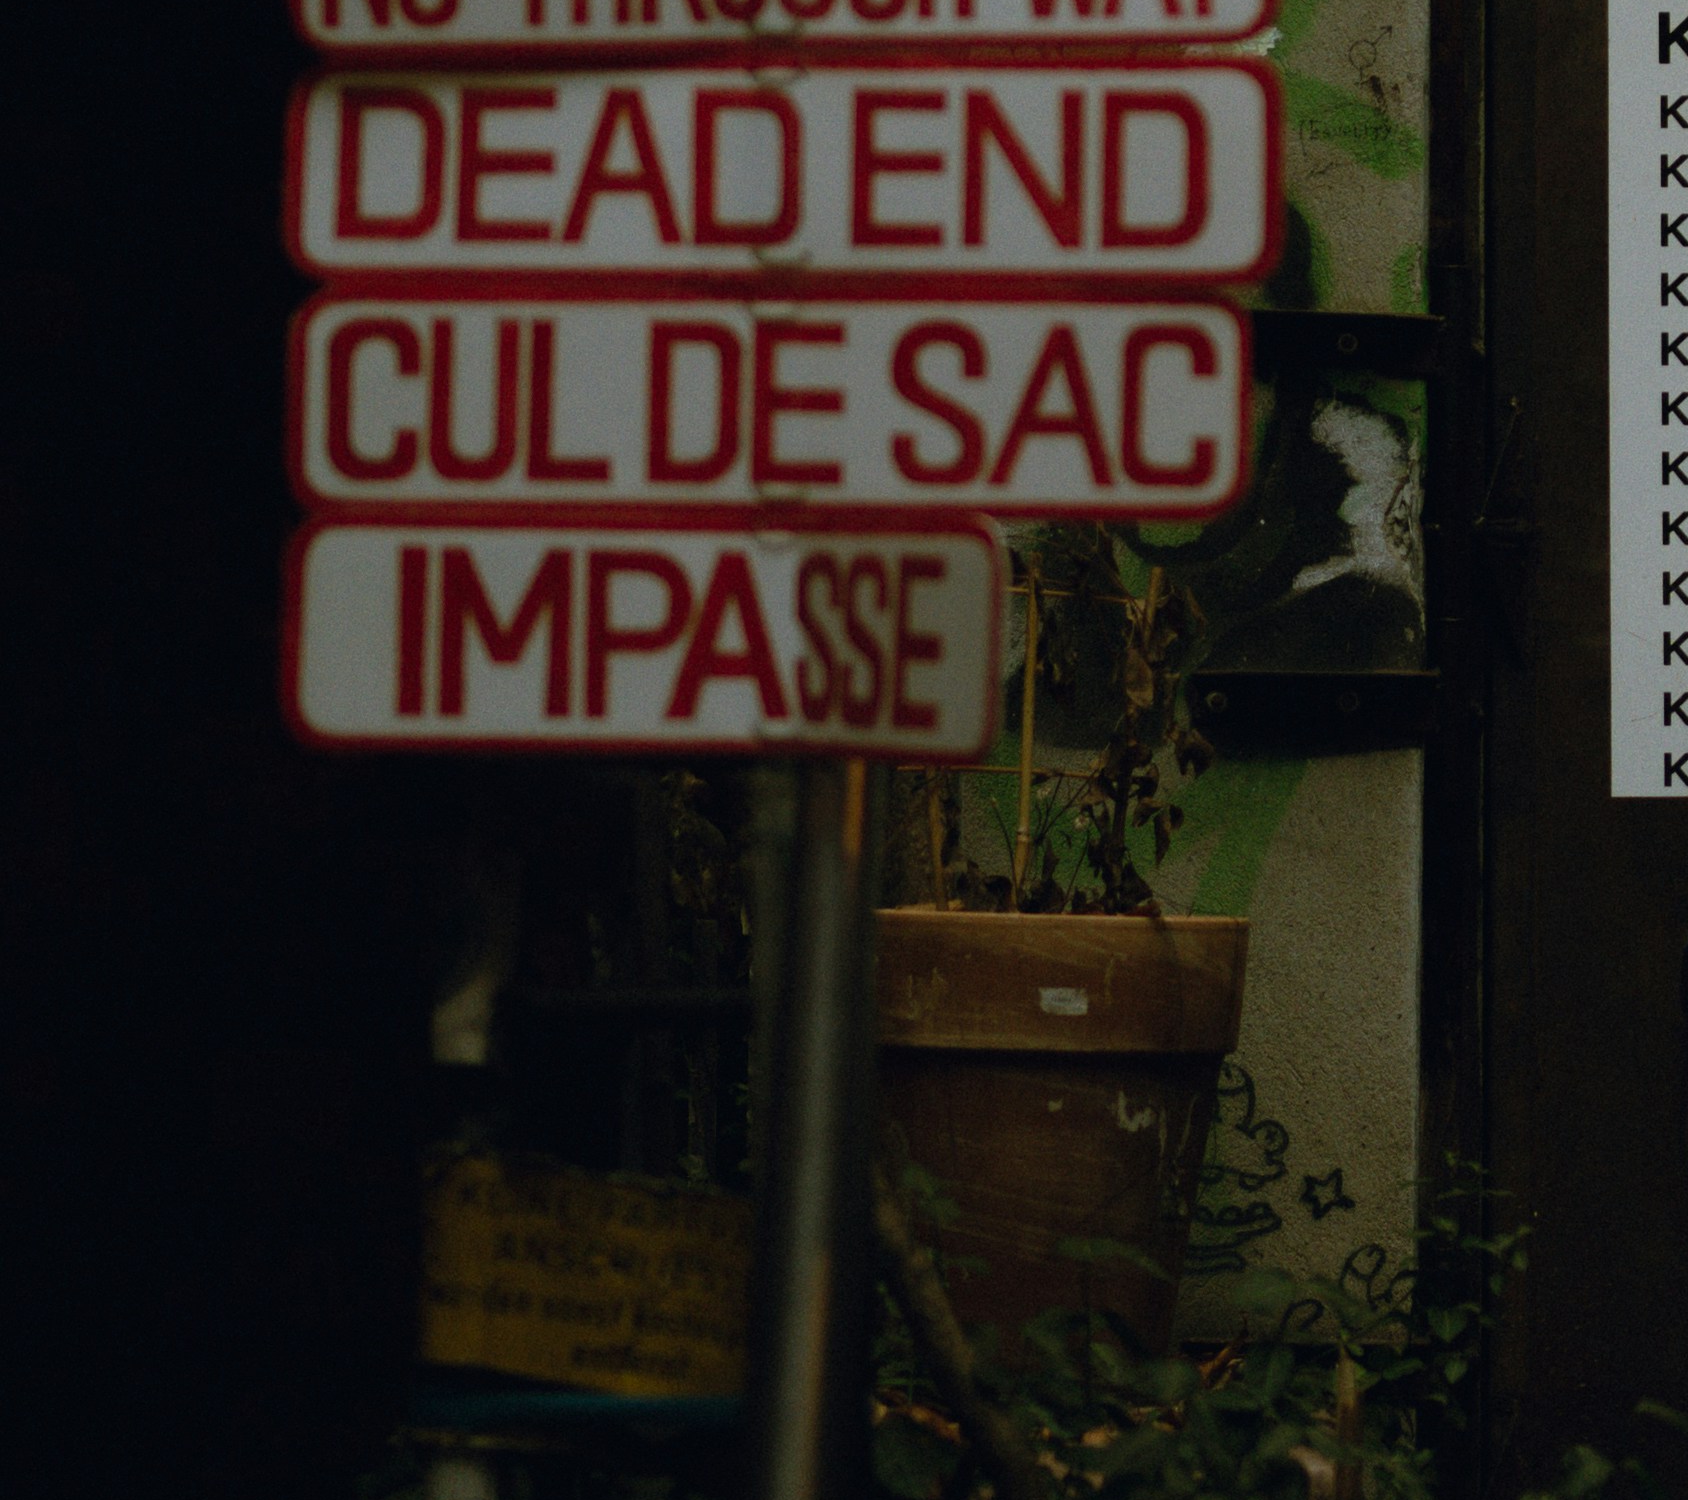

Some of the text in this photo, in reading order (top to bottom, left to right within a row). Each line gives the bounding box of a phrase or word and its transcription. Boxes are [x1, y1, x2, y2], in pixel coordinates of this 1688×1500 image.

[336, 84, 1208, 249] DEAD END
[326, 316, 1219, 486] CUL DE SAC
[394, 545, 946, 732] IMPASSE
